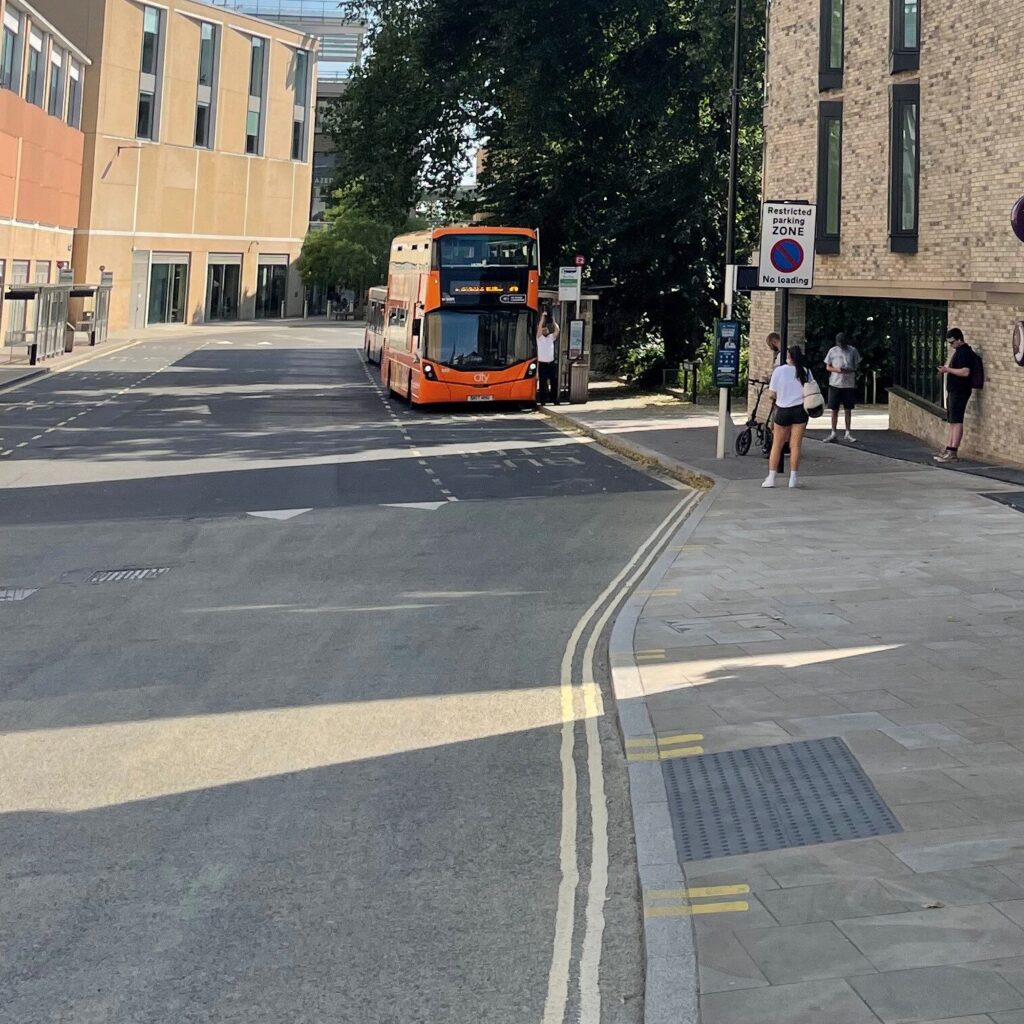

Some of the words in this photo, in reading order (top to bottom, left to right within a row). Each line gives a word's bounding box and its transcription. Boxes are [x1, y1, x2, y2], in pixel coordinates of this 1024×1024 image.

[767, 206, 812, 216] Restricted
[772, 217, 805, 226] parking
[772, 226, 805, 236] ZONE
[762, 275, 775, 284] No
[777, 276, 809, 286] loading
[473, 372, 490, 384] city
